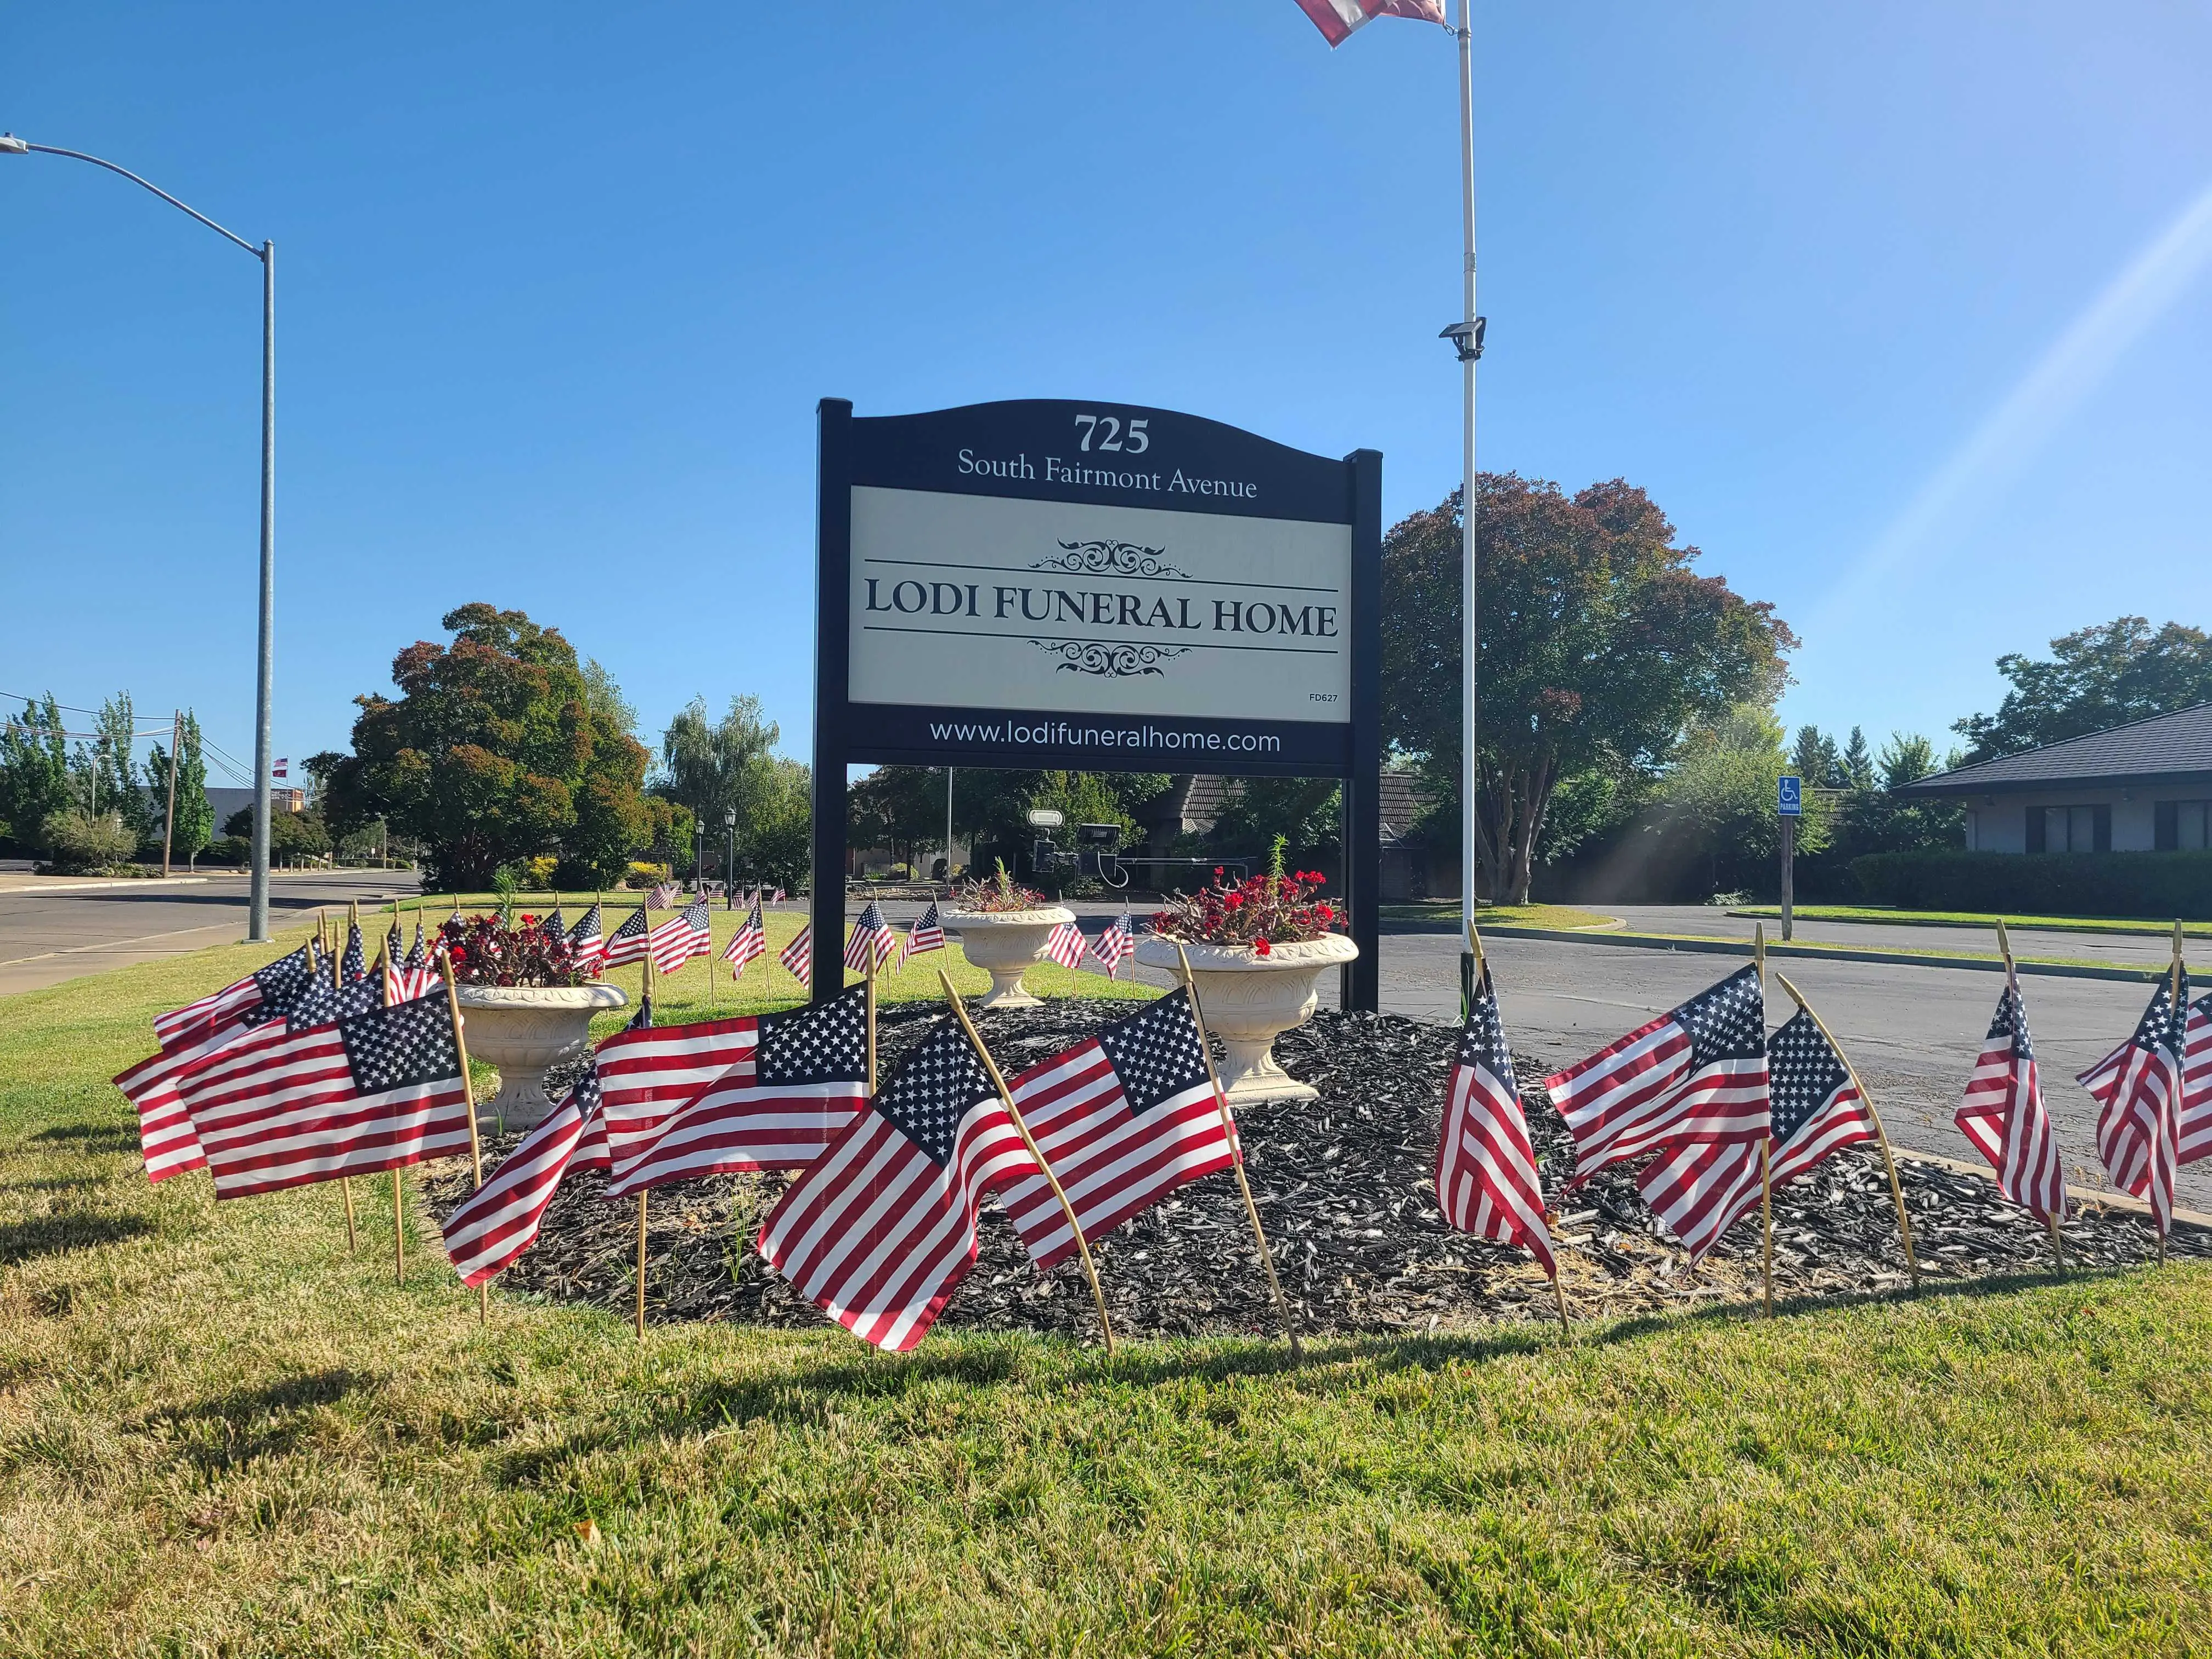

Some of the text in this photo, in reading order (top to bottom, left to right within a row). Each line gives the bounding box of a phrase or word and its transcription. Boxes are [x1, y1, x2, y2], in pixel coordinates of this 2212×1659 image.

[1075, 414, 1149, 454] 725
[958, 449, 1257, 498] South Fairmont Avenue
[864, 578, 1339, 637] LODI FUNERAL HOME
[1309, 693, 1338, 702] FD627
[930, 720, 1280, 752] www.lodifuneralhome.com
